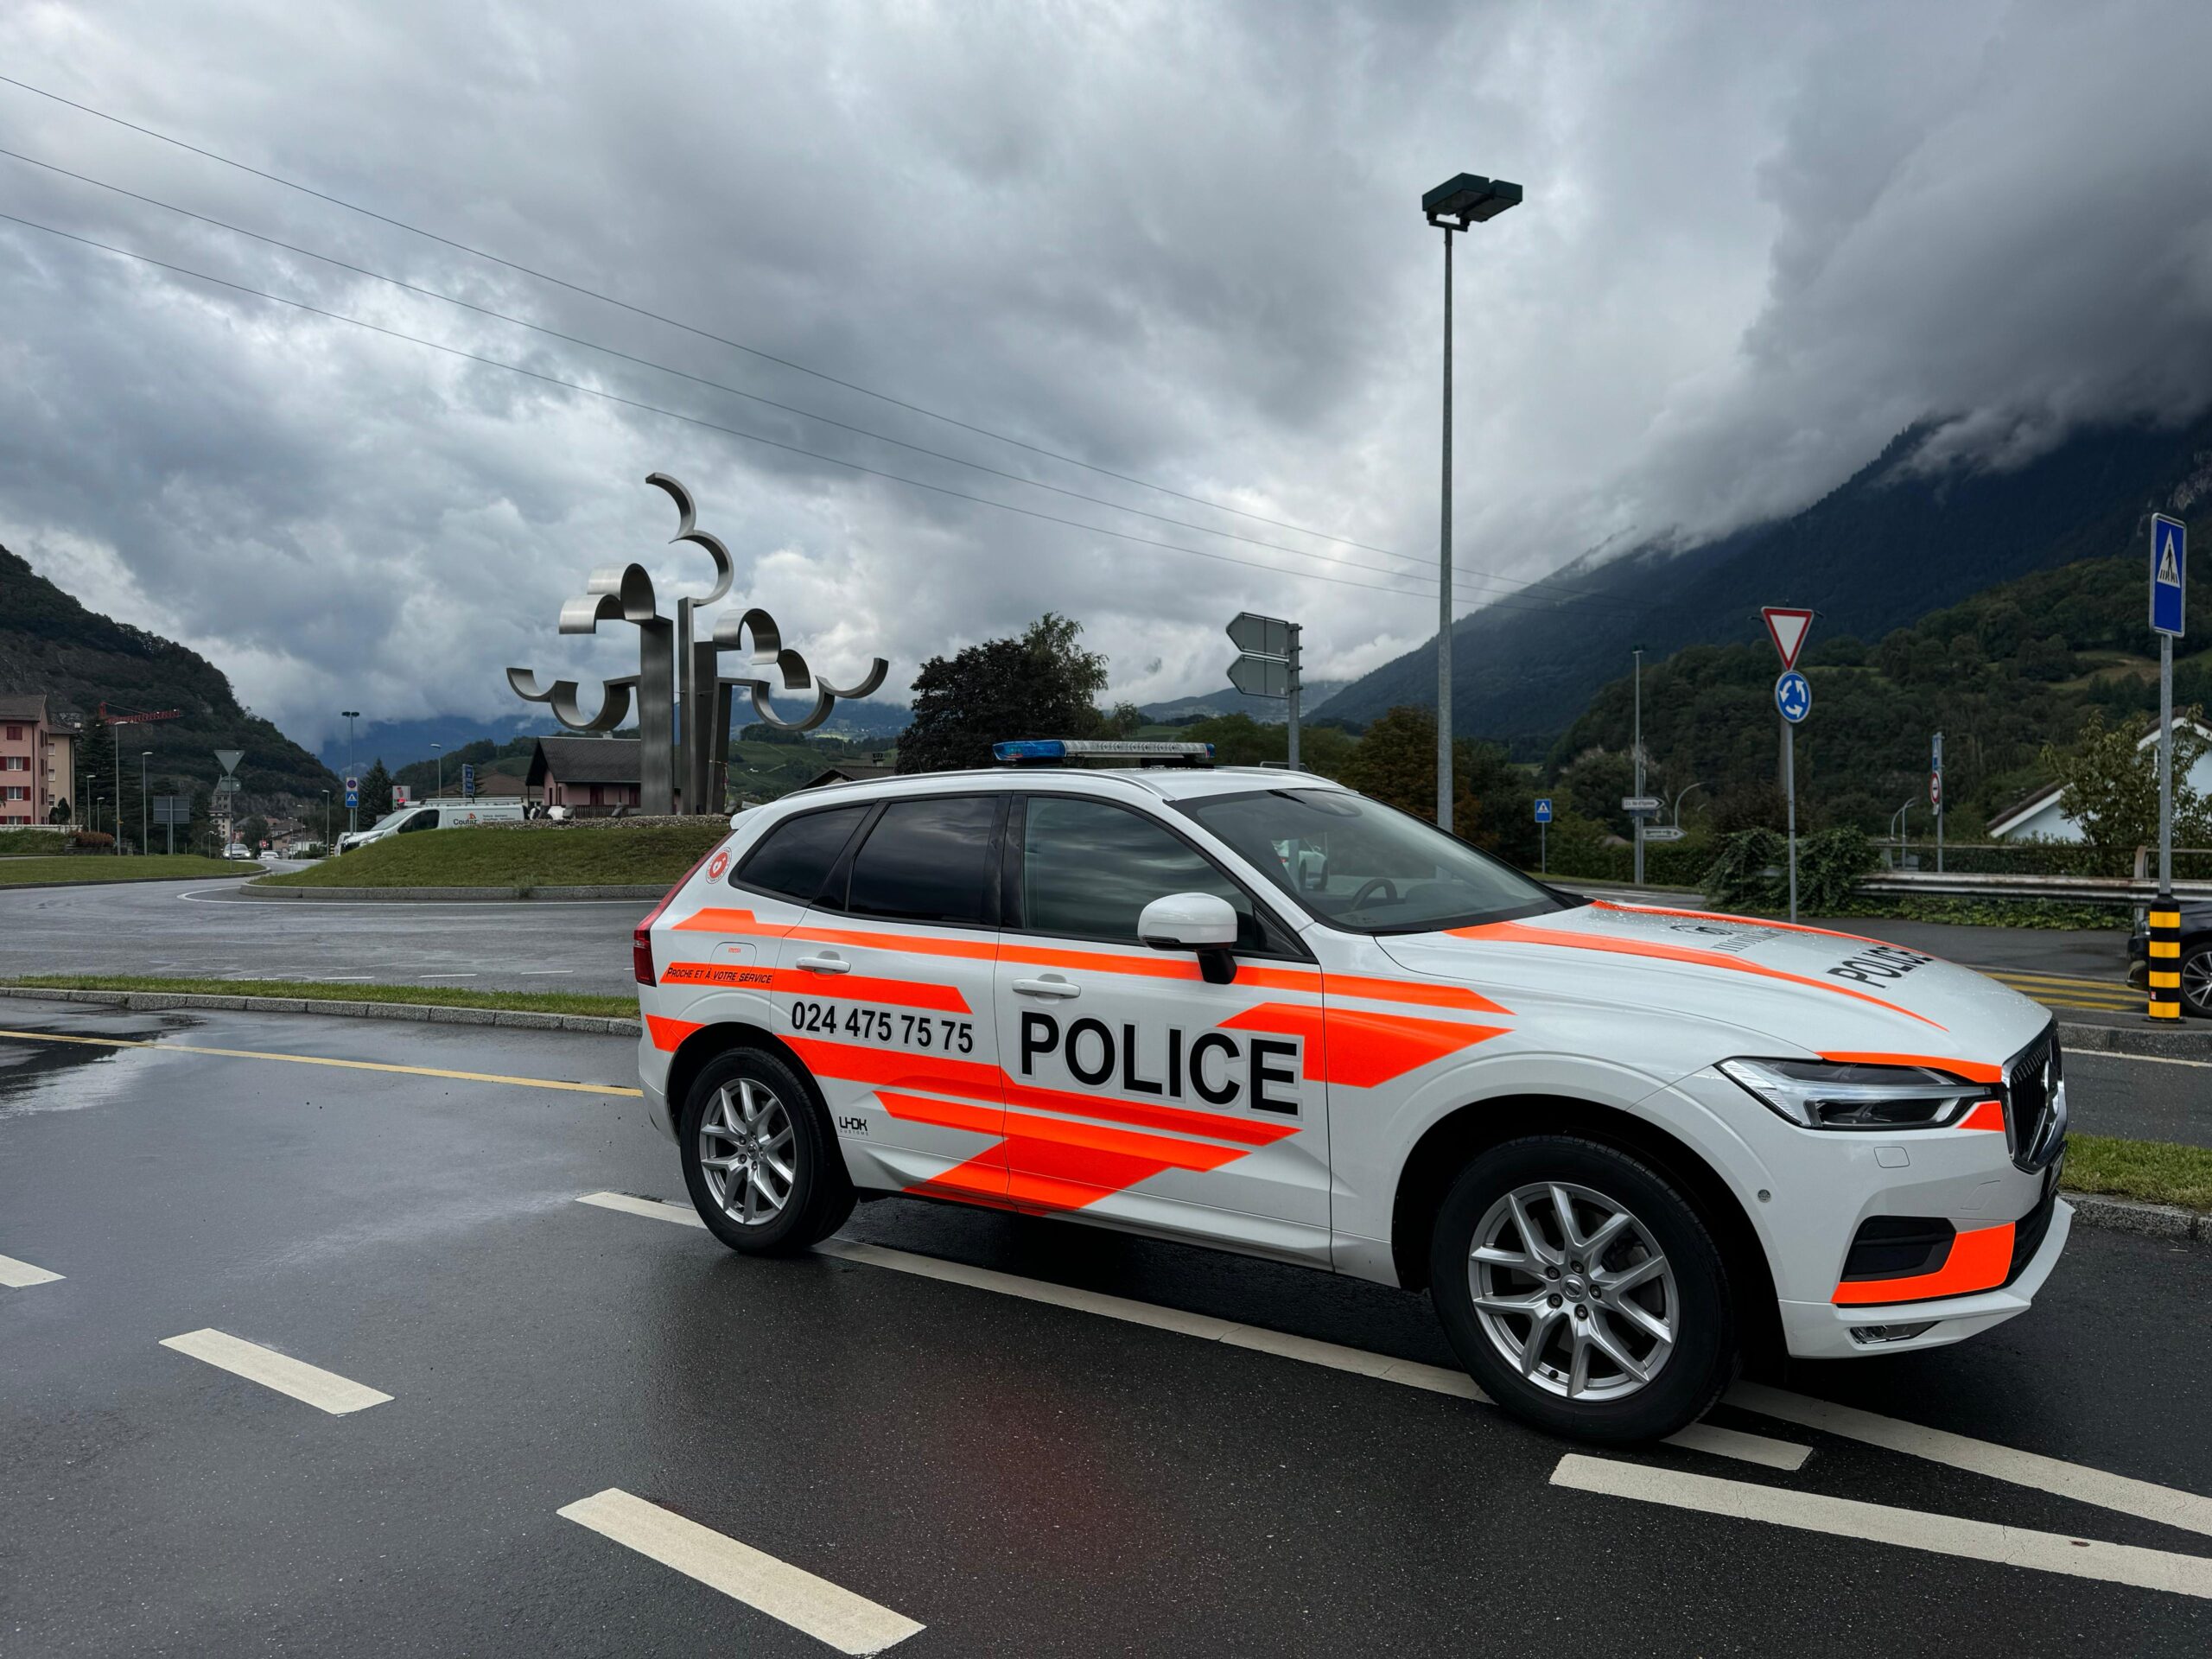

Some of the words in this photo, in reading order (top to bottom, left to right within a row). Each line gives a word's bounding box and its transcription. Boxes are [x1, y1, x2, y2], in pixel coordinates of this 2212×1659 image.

[665, 967, 693, 979] PROCHE
[694, 969, 705, 979] ET
[705, 967, 711, 980] À
[713, 970, 737, 981] VOTRE
[738, 972, 773, 984] SERVICE
[791, 1001, 837, 1034] 024
[845, 1007, 892, 1042] 475
[900, 1014, 932, 1047] 75
[941, 1020, 974, 1054] 75
[1021, 1010, 1299, 1117] POLICE
